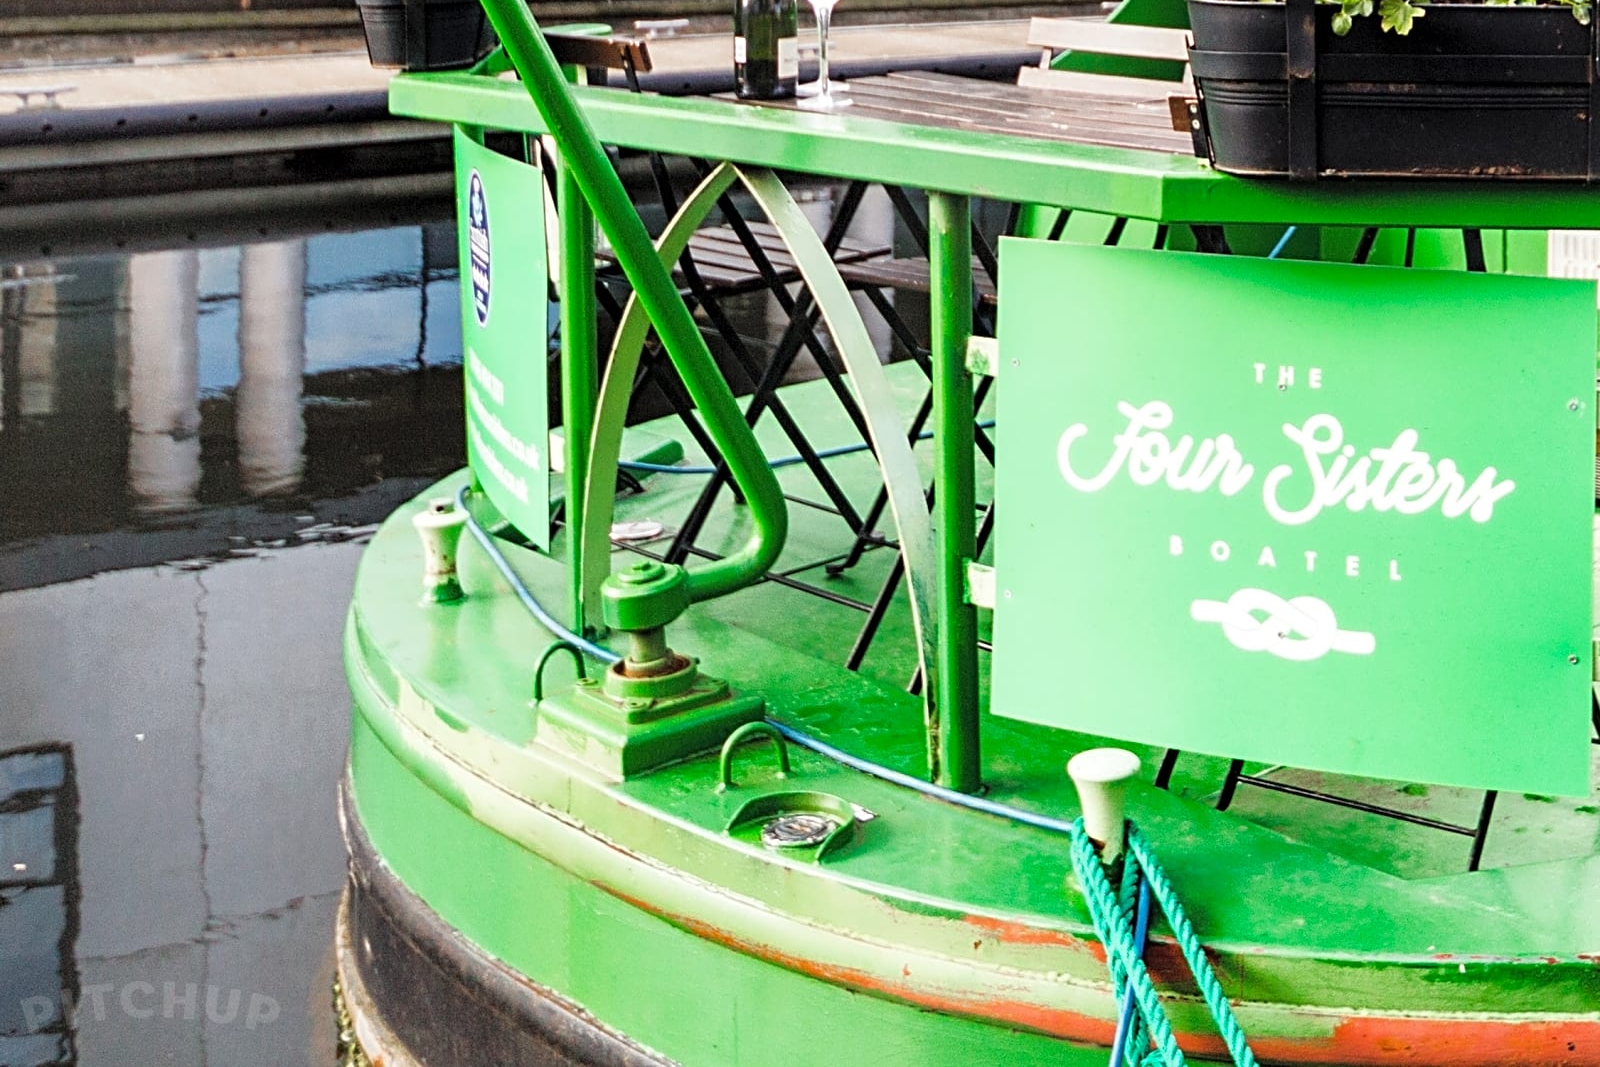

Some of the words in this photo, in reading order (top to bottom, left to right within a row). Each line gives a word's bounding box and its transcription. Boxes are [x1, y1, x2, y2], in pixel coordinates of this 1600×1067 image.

[1254, 362, 1323, 389] THE
[1057, 400, 1254, 497] Four
[1263, 413, 1516, 525] Sisters
[1168, 534, 1402, 581] BOATEL
